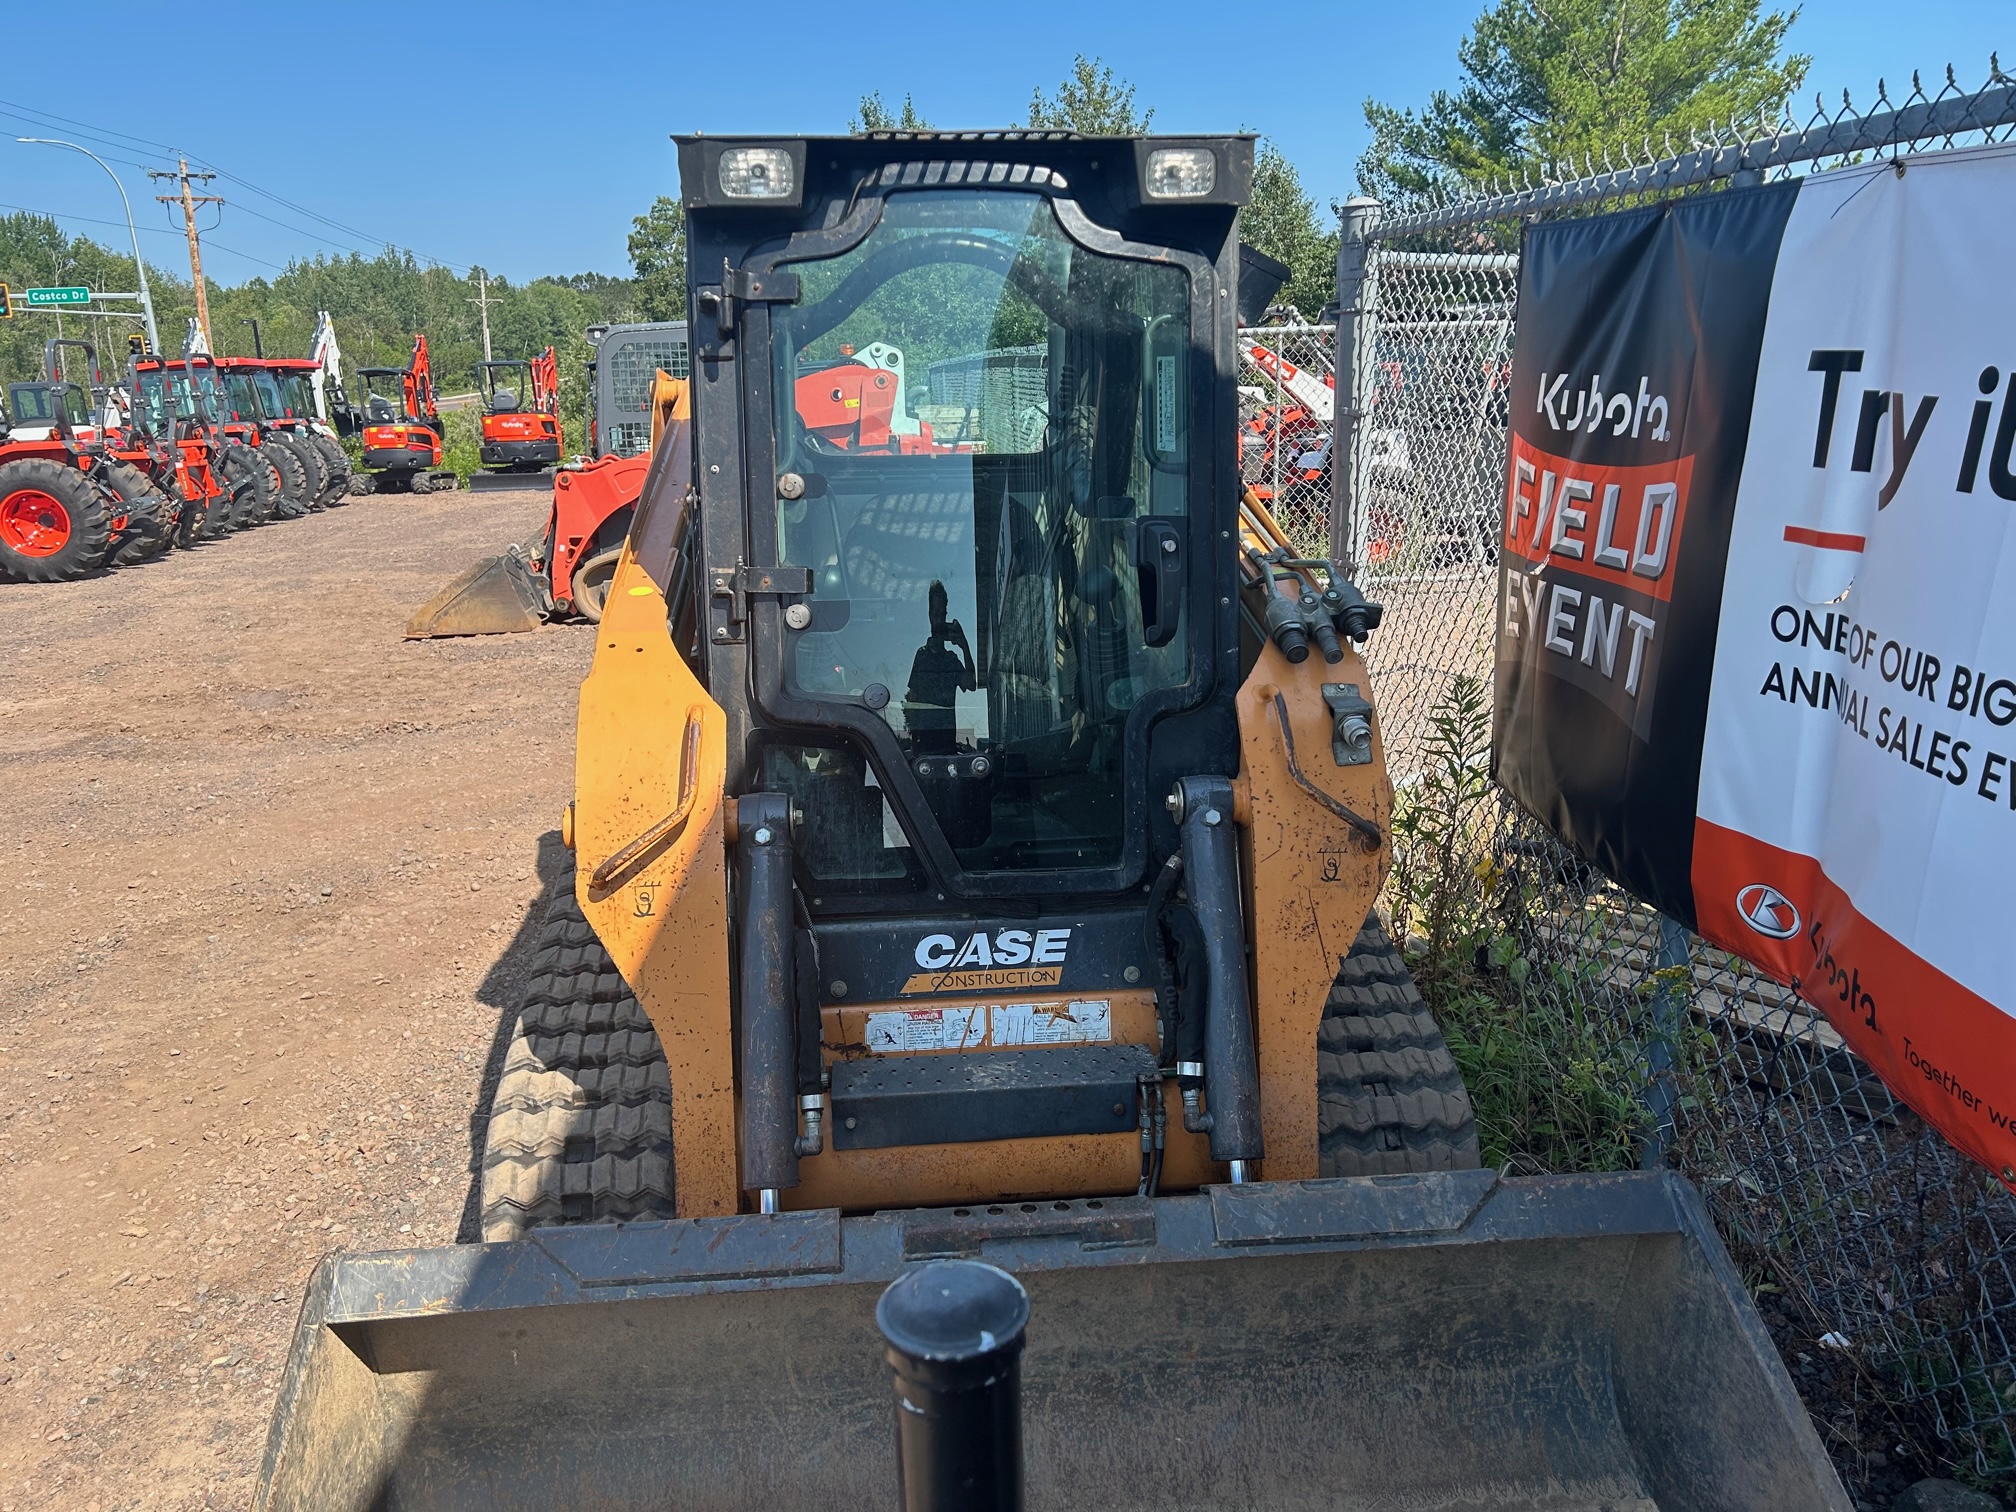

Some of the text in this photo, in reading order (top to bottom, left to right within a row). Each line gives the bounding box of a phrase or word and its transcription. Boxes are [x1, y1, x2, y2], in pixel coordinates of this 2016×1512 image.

[32, 291, 85, 301] Costco Dr
[1807, 349, 1940, 512] Try
[1509, 454, 1678, 580] FIELD
[1504, 567, 1656, 697] EVENT
[1770, 604, 2016, 727] ONE OF OUR BIG
[1759, 661, 1869, 740] ANNUAL
[1874, 706, 1972, 786] SALES
[914, 928, 1072, 969] CASE
[930, 970, 1056, 988] CONSTRUCTION
[914, 1012, 939, 1021] DANGER
[1903, 1036, 1982, 1113] Together
